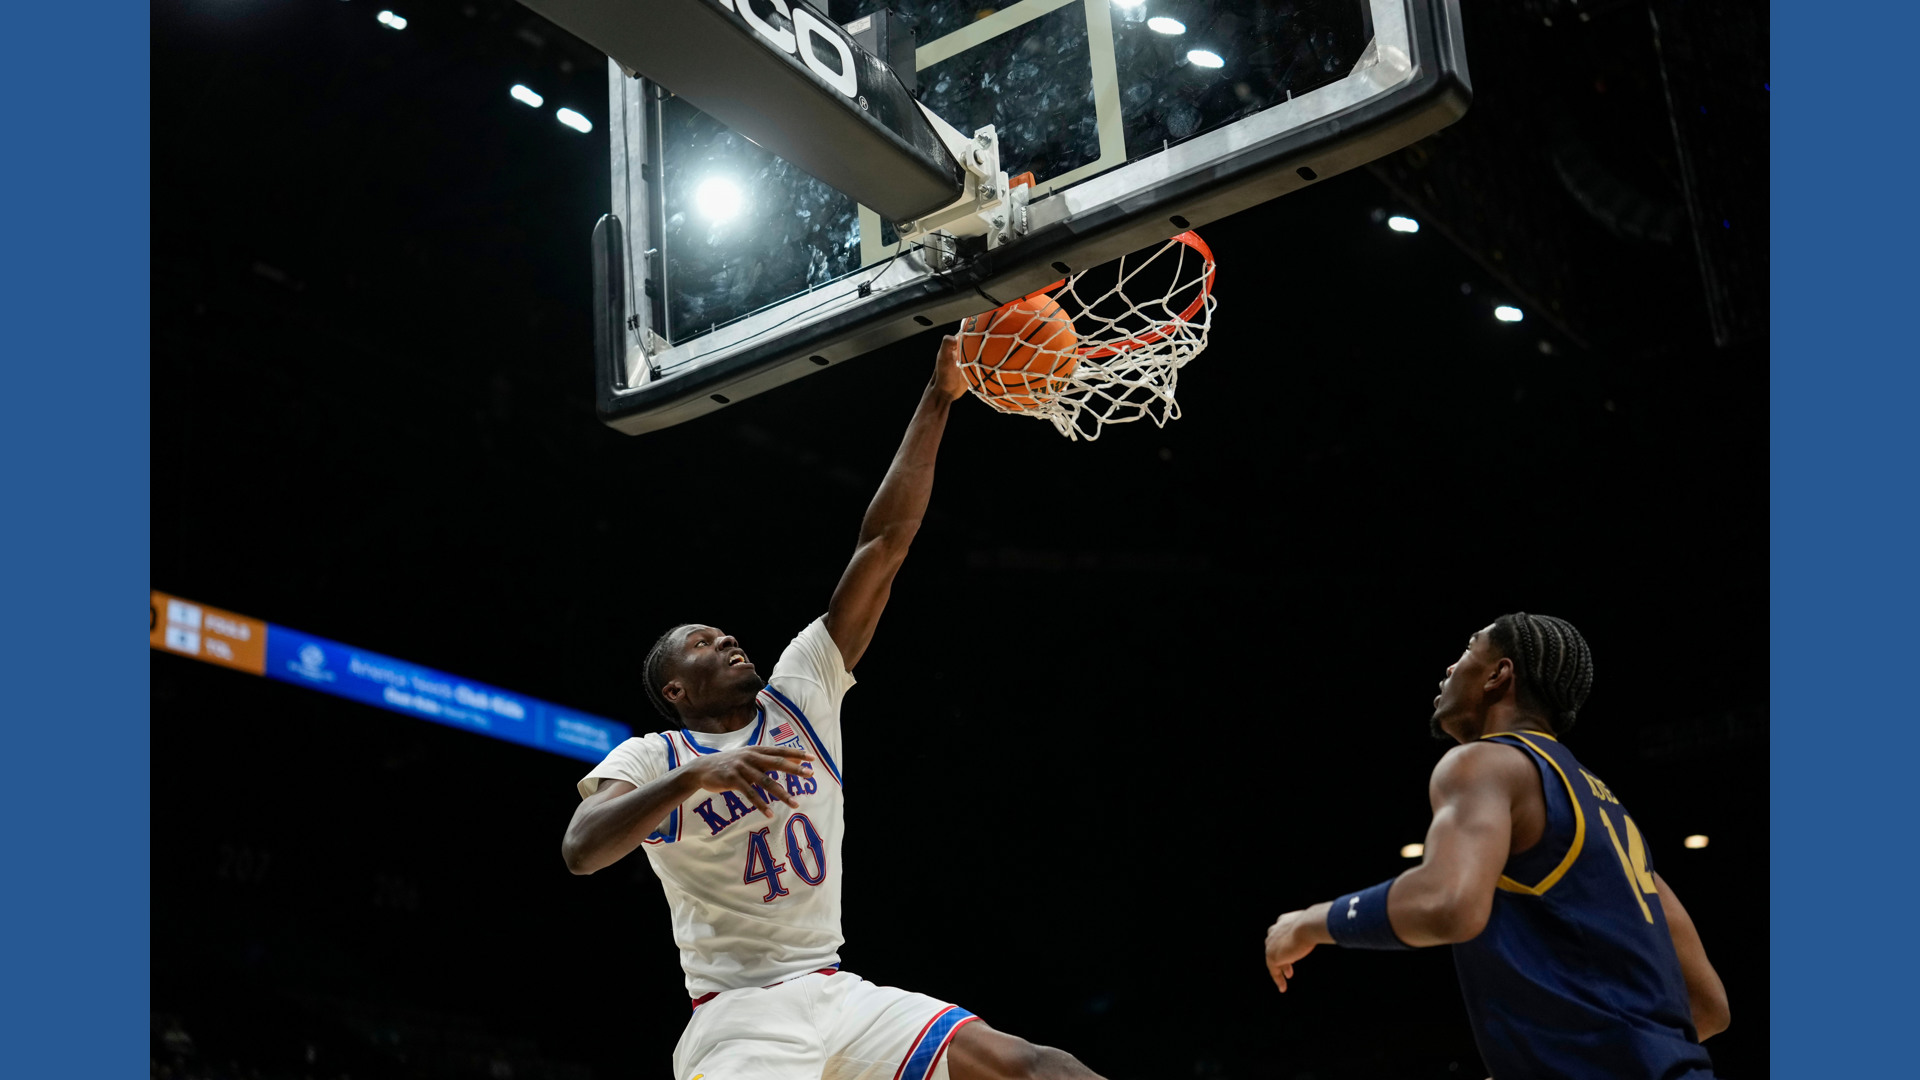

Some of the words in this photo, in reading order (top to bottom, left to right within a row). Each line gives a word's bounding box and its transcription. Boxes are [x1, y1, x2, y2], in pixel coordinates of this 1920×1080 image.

[718, 0, 858, 99] CO
[743, 812, 827, 903] 40
[1598, 806, 1659, 925] 14
